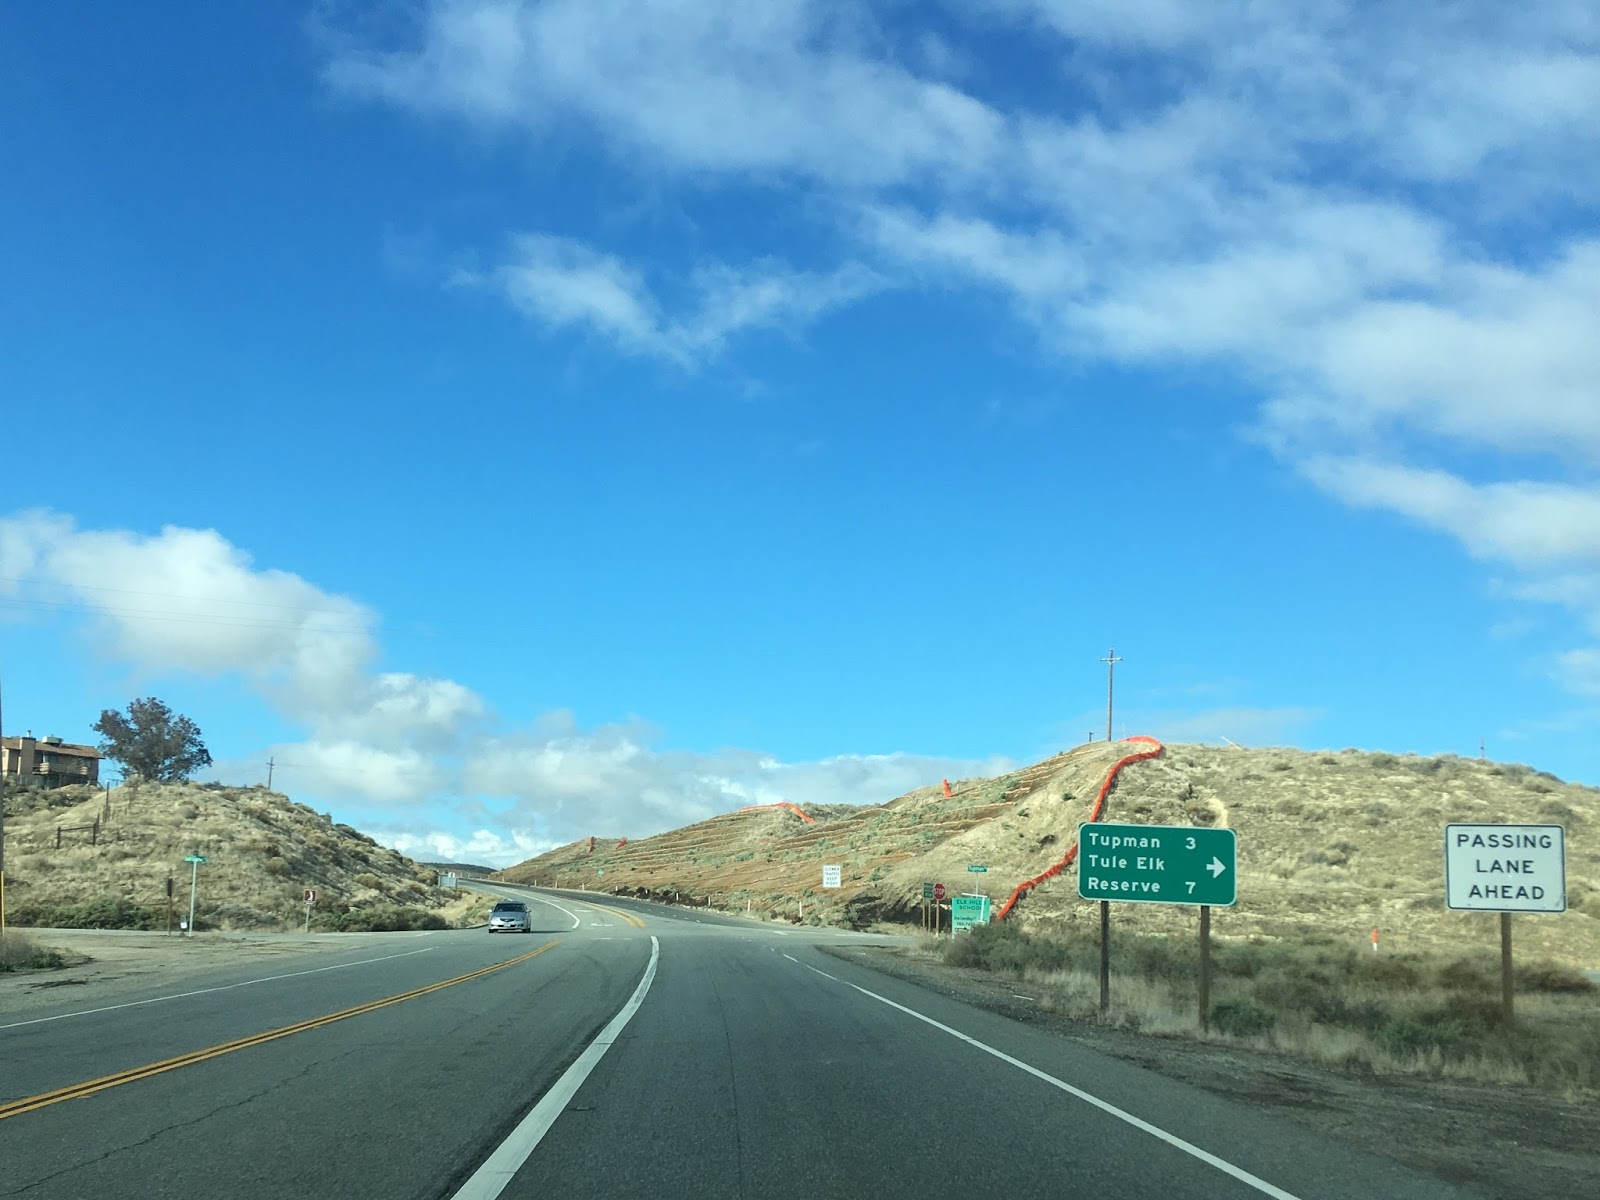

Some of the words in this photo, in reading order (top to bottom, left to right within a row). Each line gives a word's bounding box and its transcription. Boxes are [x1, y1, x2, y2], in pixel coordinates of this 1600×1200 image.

[1089, 833, 1161, 849] Tupman
[1185, 837, 1196, 850] 3
[1457, 834, 1552, 849] PASSING
[1089, 855, 1128, 869] Tule
[1137, 856, 1165, 871] Elk
[1476, 859, 1535, 874] LANE
[1088, 877, 1161, 893] Reserve
[1185, 882, 1196, 895] 7
[1468, 884, 1545, 900] AHEAD
